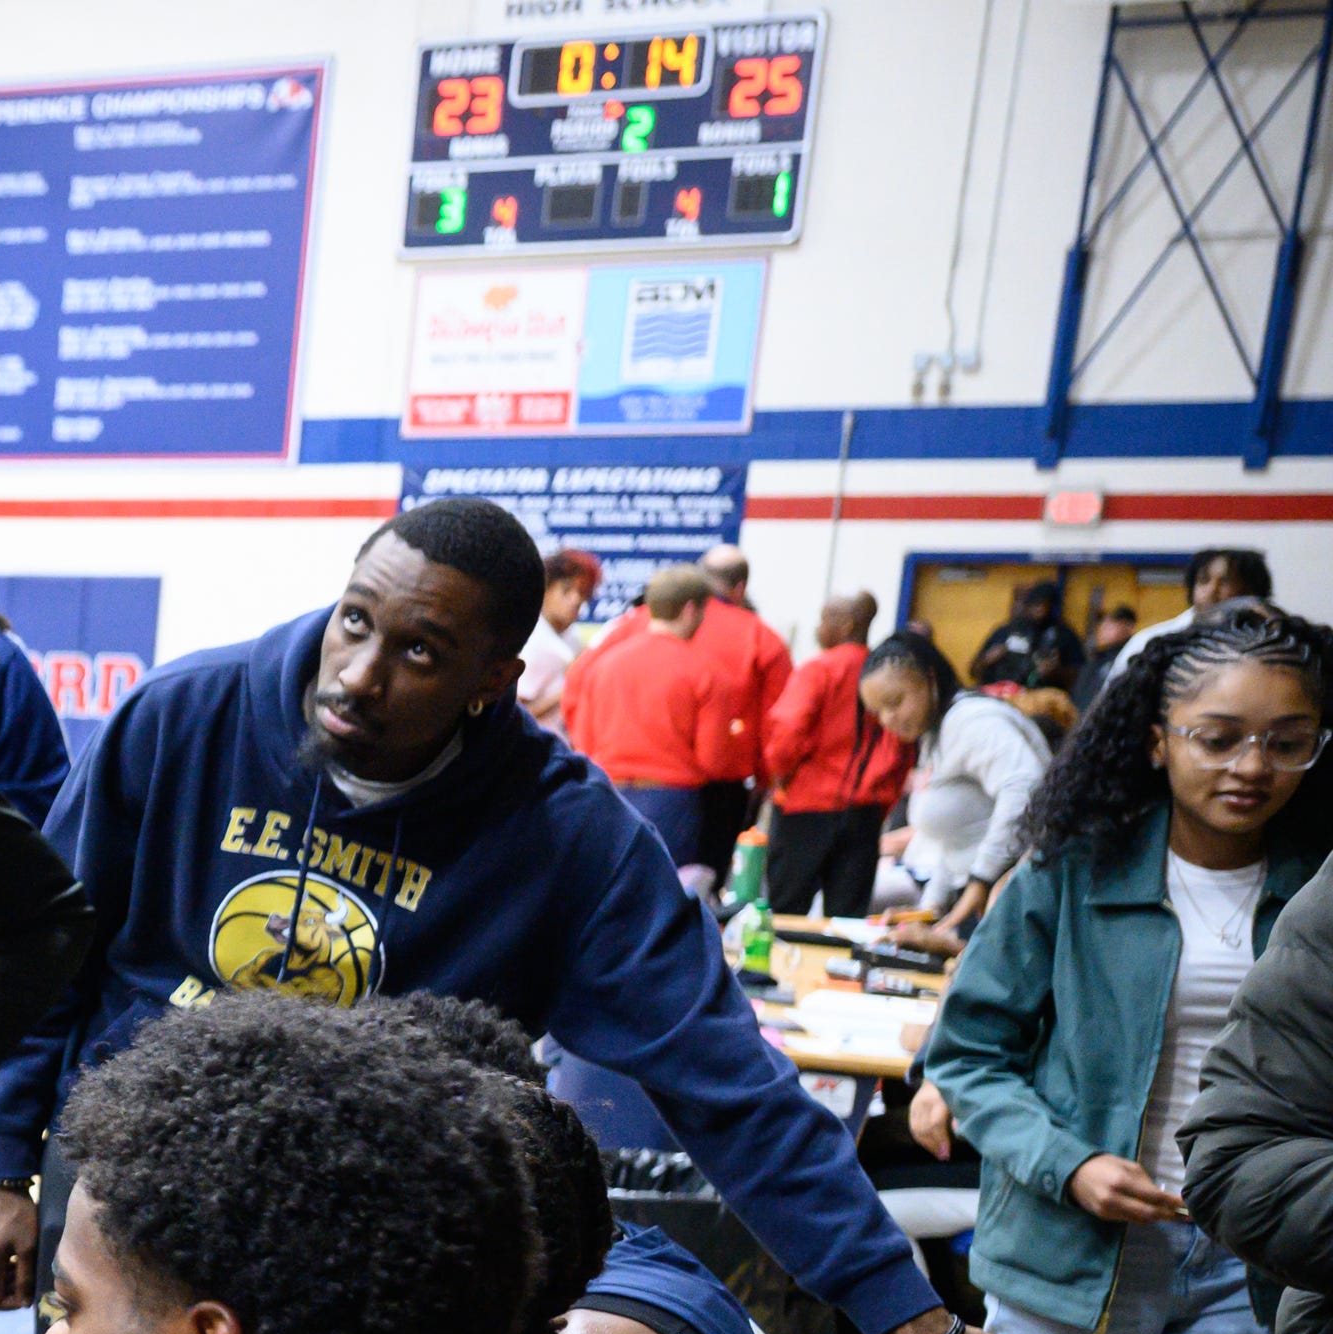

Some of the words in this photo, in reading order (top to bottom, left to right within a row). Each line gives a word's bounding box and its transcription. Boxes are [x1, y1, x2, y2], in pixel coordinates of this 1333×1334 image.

[556, 33, 698, 97] 0:14
[728, 55, 804, 118] 25
[433, 76, 504, 137] 23
[621, 105, 655, 154] 2
[435, 186, 468, 234] 3
[493, 195, 518, 230] 4
[676, 187, 702, 222] 4
[772, 170, 792, 217] 1
[30, 652, 147, 718] RD
[220, 806, 290, 861] E.E.
[296, 827, 432, 913] SMITH
